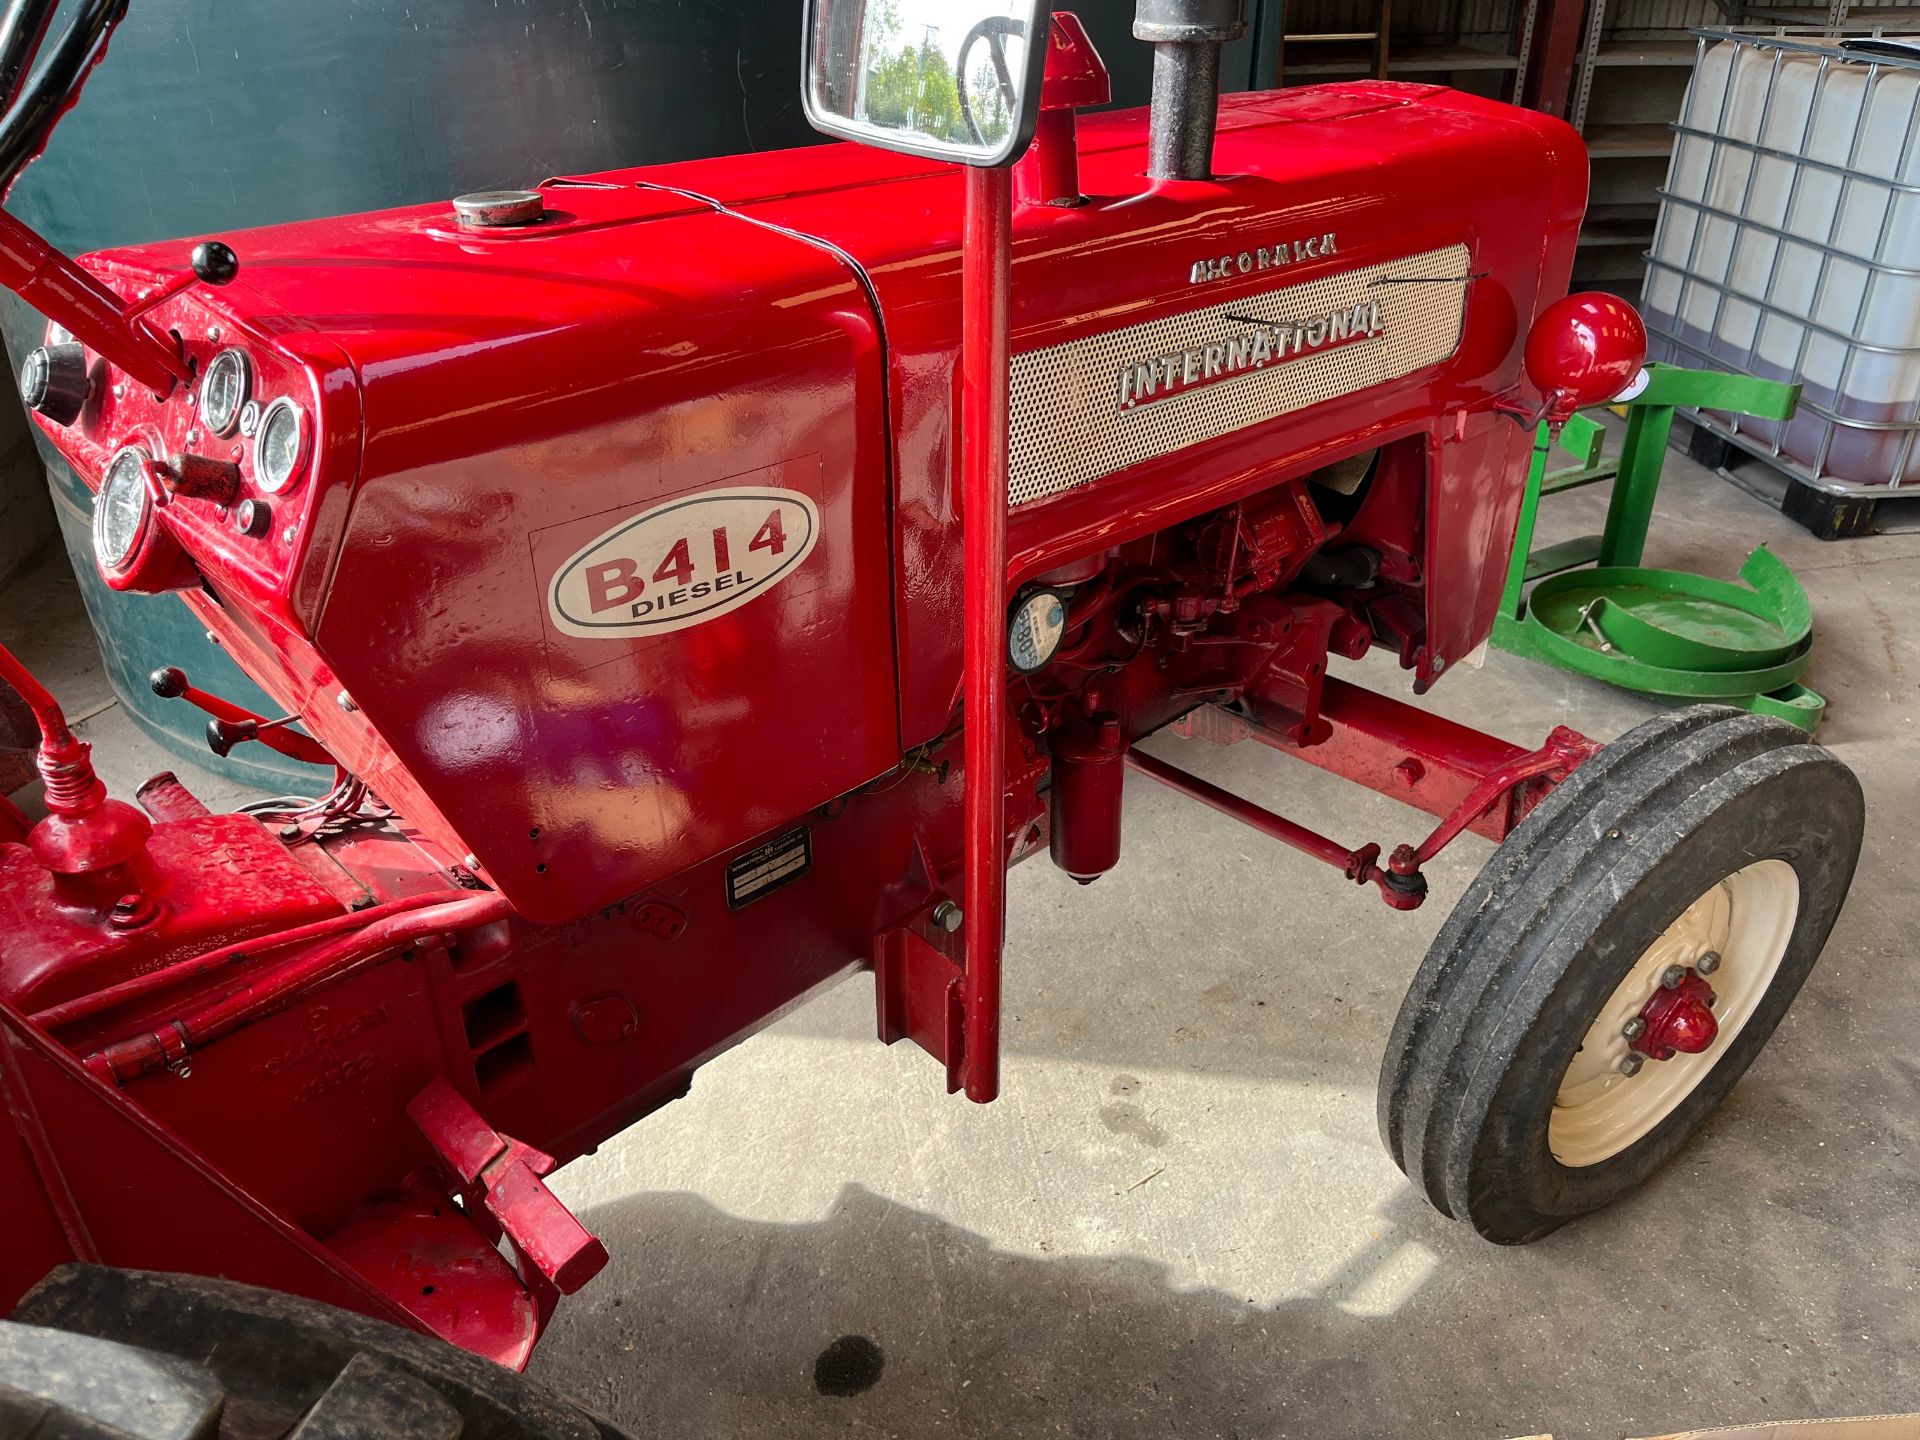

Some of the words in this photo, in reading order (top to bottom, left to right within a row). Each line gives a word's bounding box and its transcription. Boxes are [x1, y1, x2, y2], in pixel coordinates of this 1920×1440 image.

[1119, 299, 1385, 404] INTERNATIONAL
[585, 509, 787, 614] B414
[631, 571, 754, 619] DIESEL
[1018, 626, 1034, 653] 08
